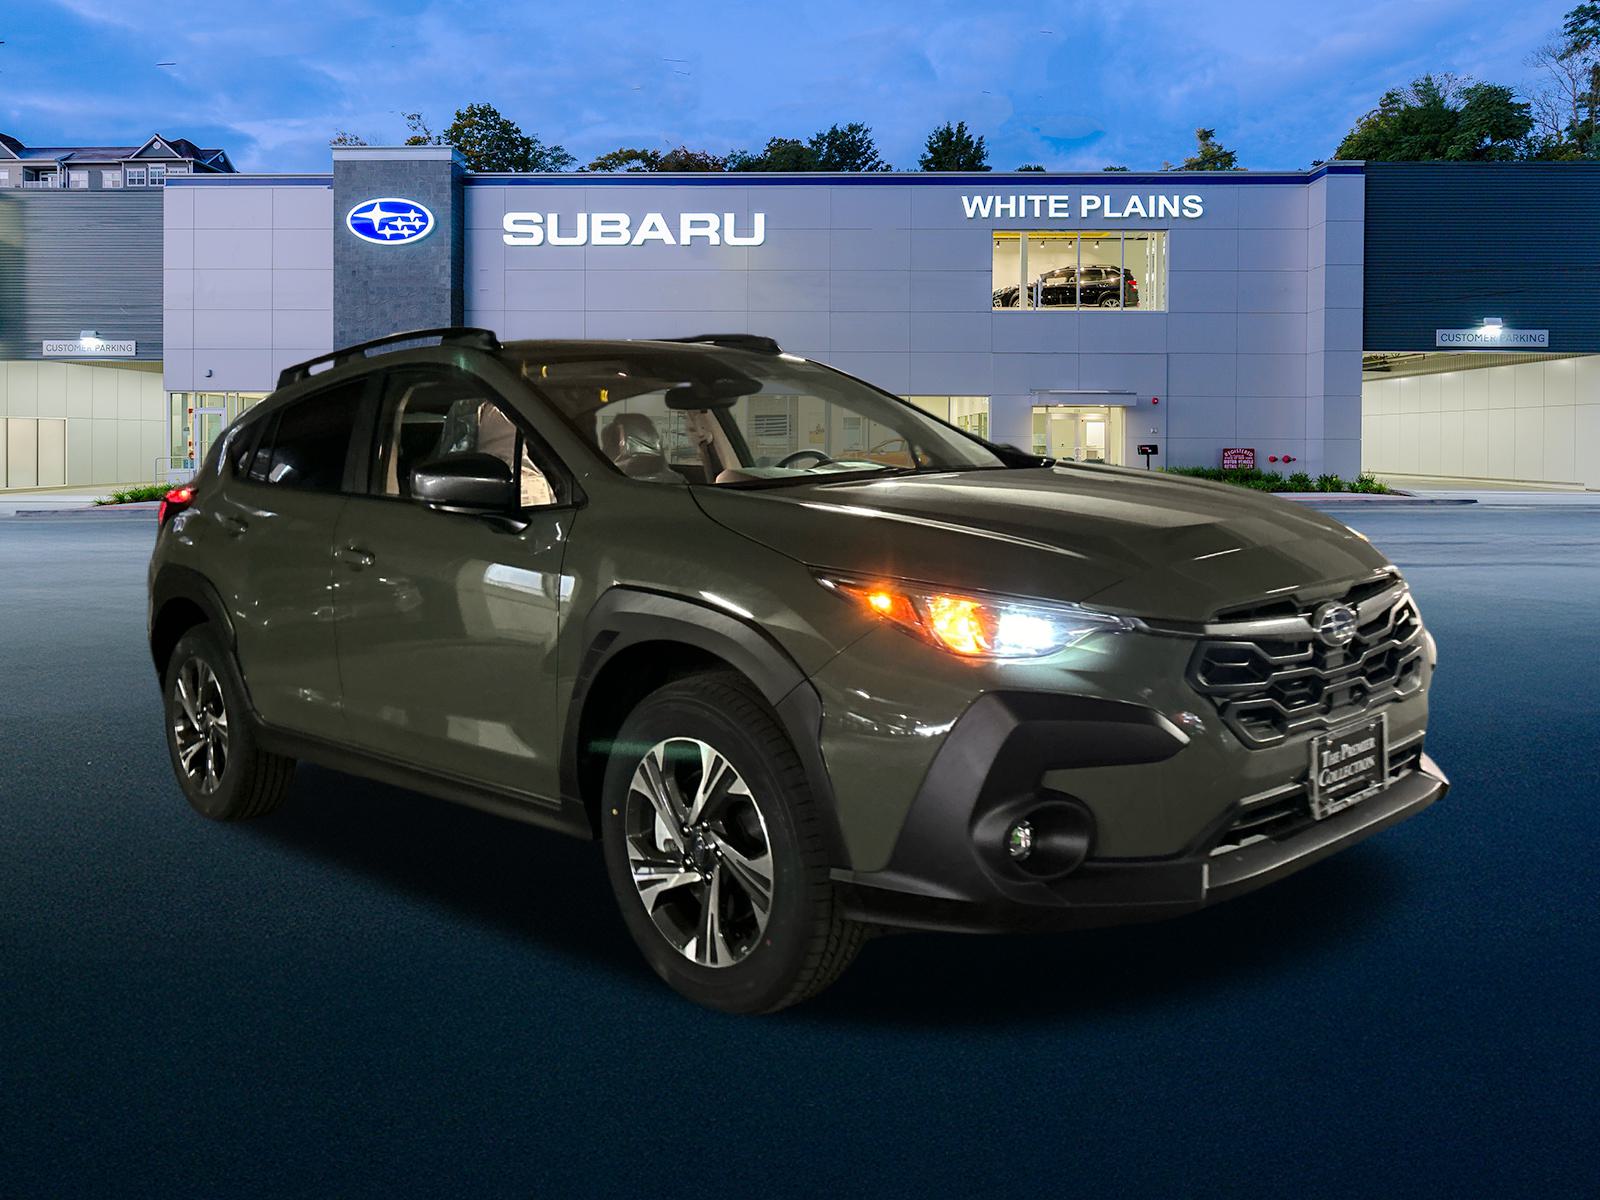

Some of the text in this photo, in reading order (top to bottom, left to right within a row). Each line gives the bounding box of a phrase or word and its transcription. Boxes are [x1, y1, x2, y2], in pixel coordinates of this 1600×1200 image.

[961, 194, 1204, 219] WHITE PLAINS
[502, 212, 766, 247] SUBARU
[1440, 333, 1545, 343] CUSTOMER PARKING
[95, 344, 133, 352] PARKING
